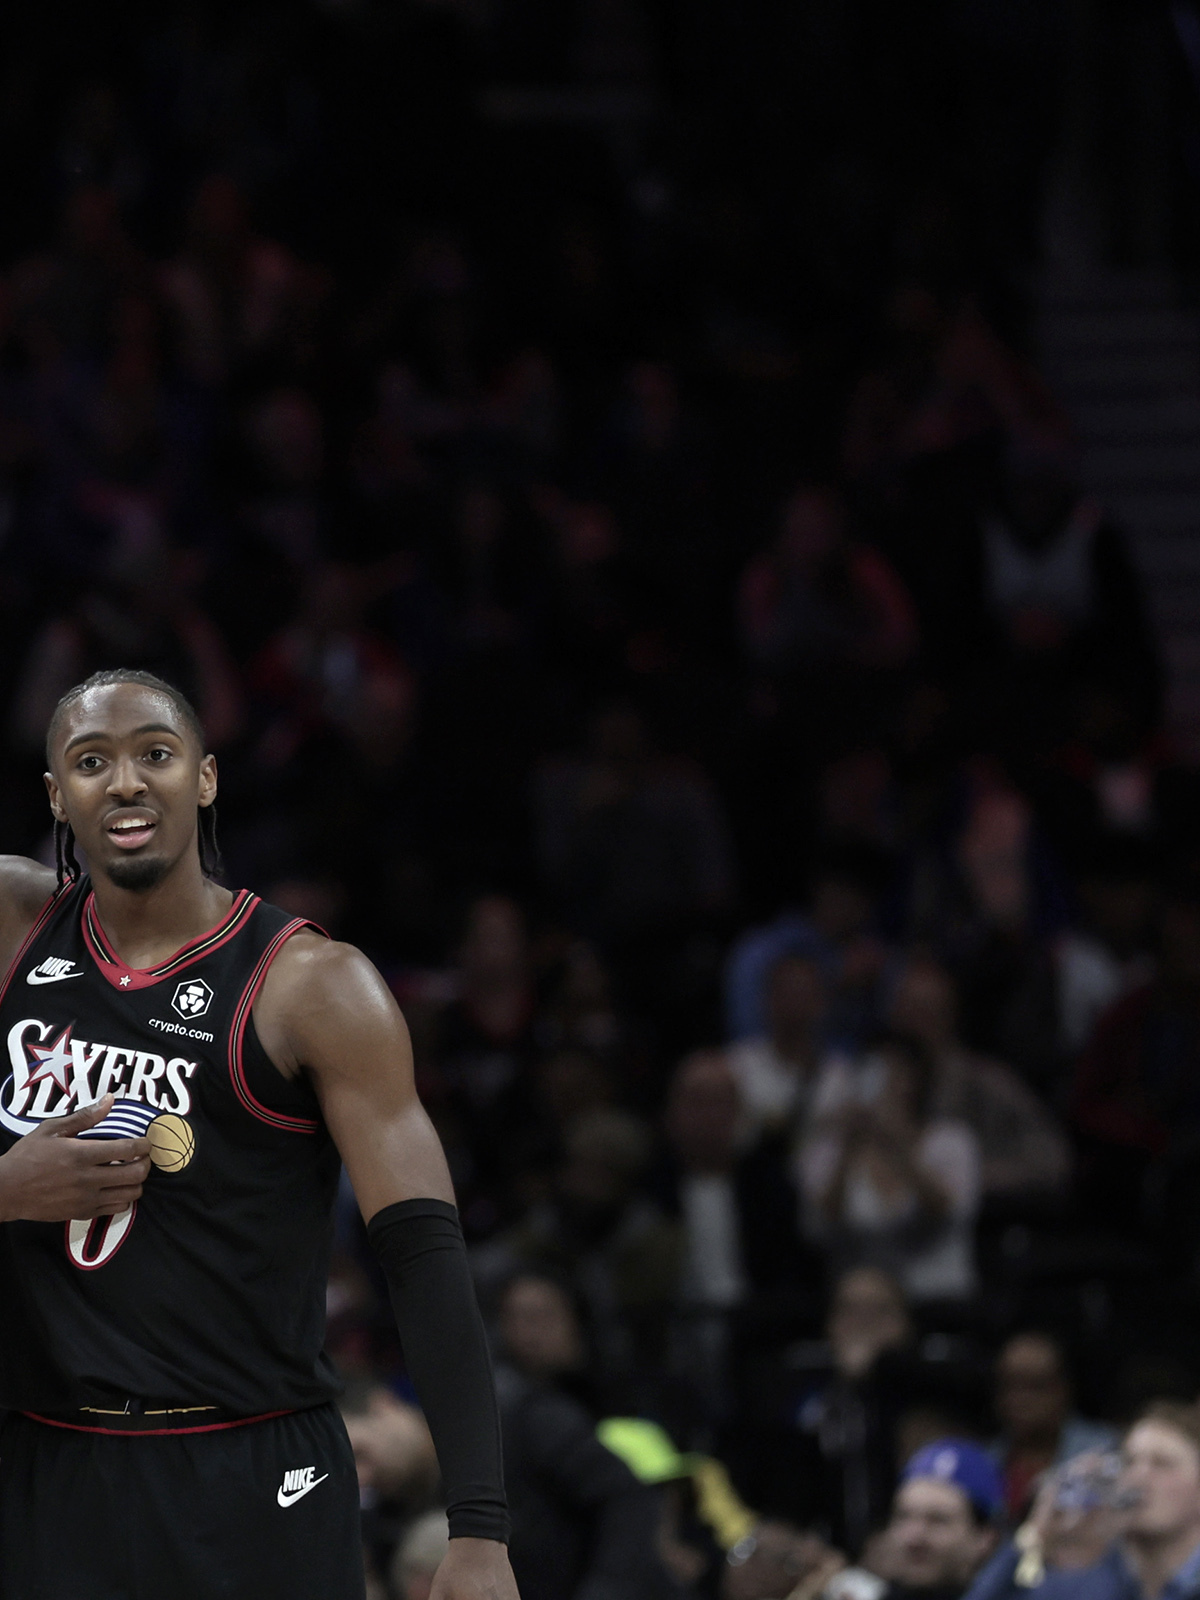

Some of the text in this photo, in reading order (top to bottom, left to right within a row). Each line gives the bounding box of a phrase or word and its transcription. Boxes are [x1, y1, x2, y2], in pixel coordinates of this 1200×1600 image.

[37, 956, 76, 977] NIKE
[148, 1018, 214, 1043] crypto.com
[283, 1466, 316, 1493] NIKE
